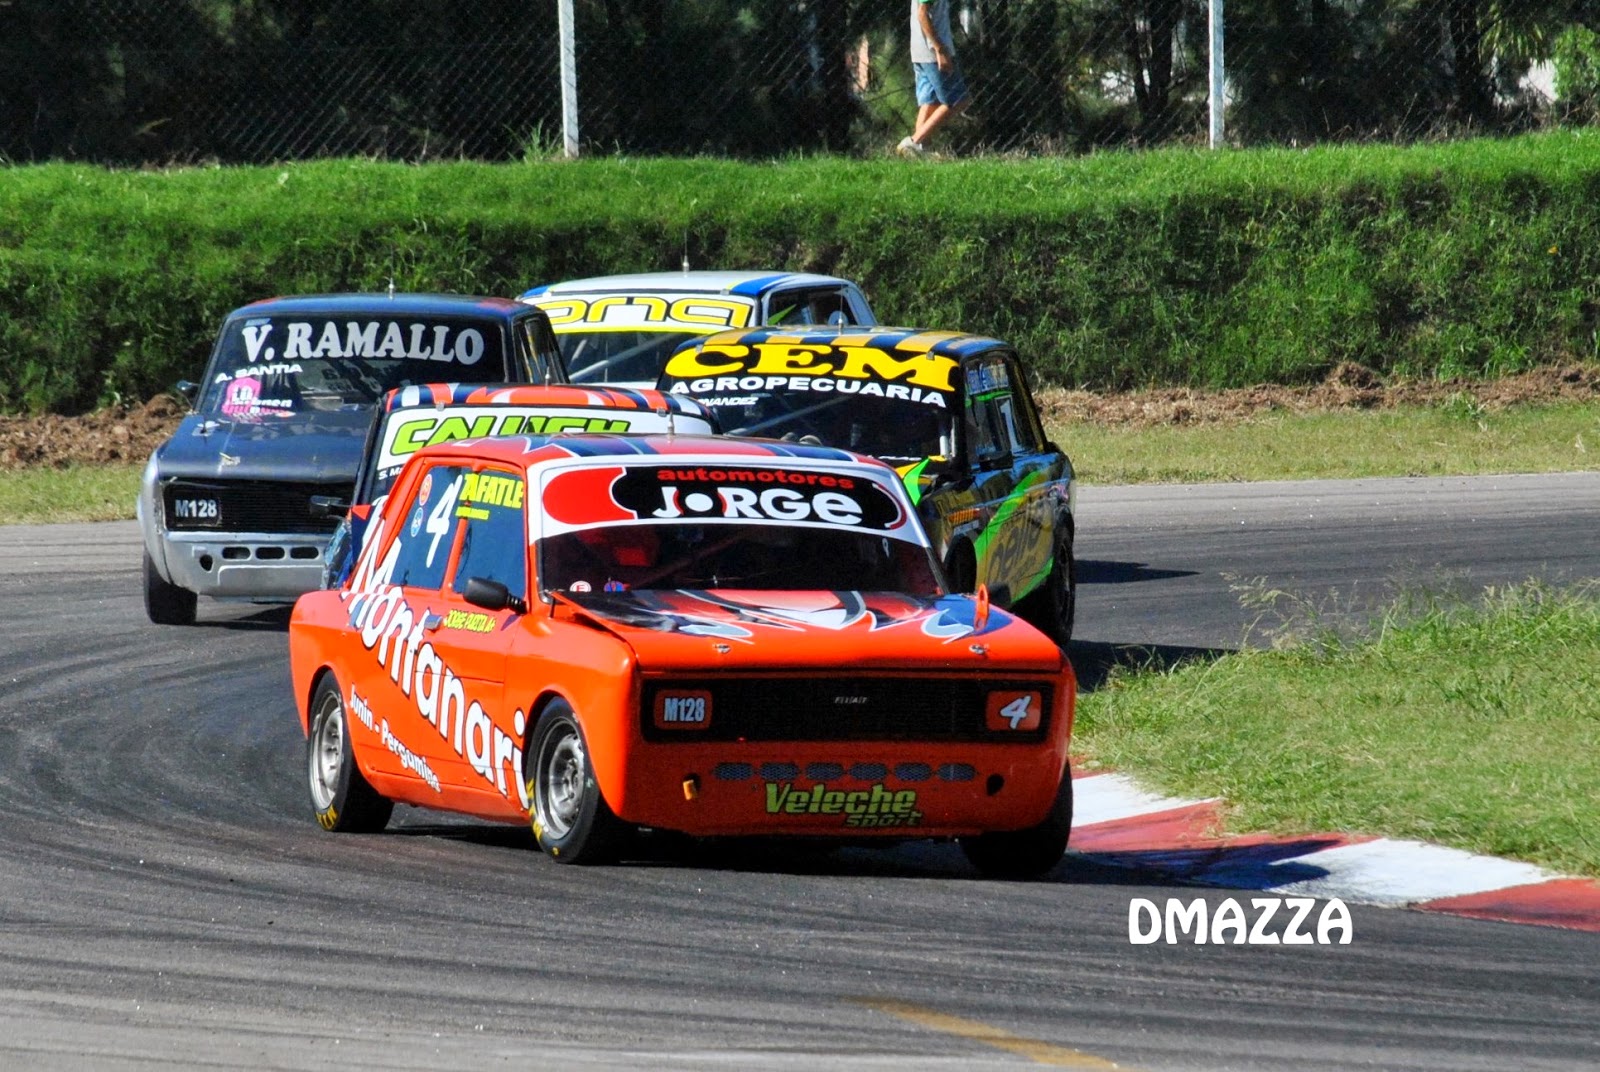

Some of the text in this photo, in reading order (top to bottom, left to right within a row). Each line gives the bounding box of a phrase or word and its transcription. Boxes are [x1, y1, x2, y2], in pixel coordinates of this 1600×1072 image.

[242, 321, 485, 366] V. RAMALLO
[665, 344, 960, 391] CEM
[670, 376, 947, 408] AGROPECUARIA
[657, 468, 854, 490] automotores
[175, 500, 217, 517] M128
[426, 474, 463, 568] 4
[340, 494, 528, 810] Montanari
[664, 698, 705, 722] M128
[1000, 695, 1031, 730] 4
[765, 783, 917, 813] Veleche
